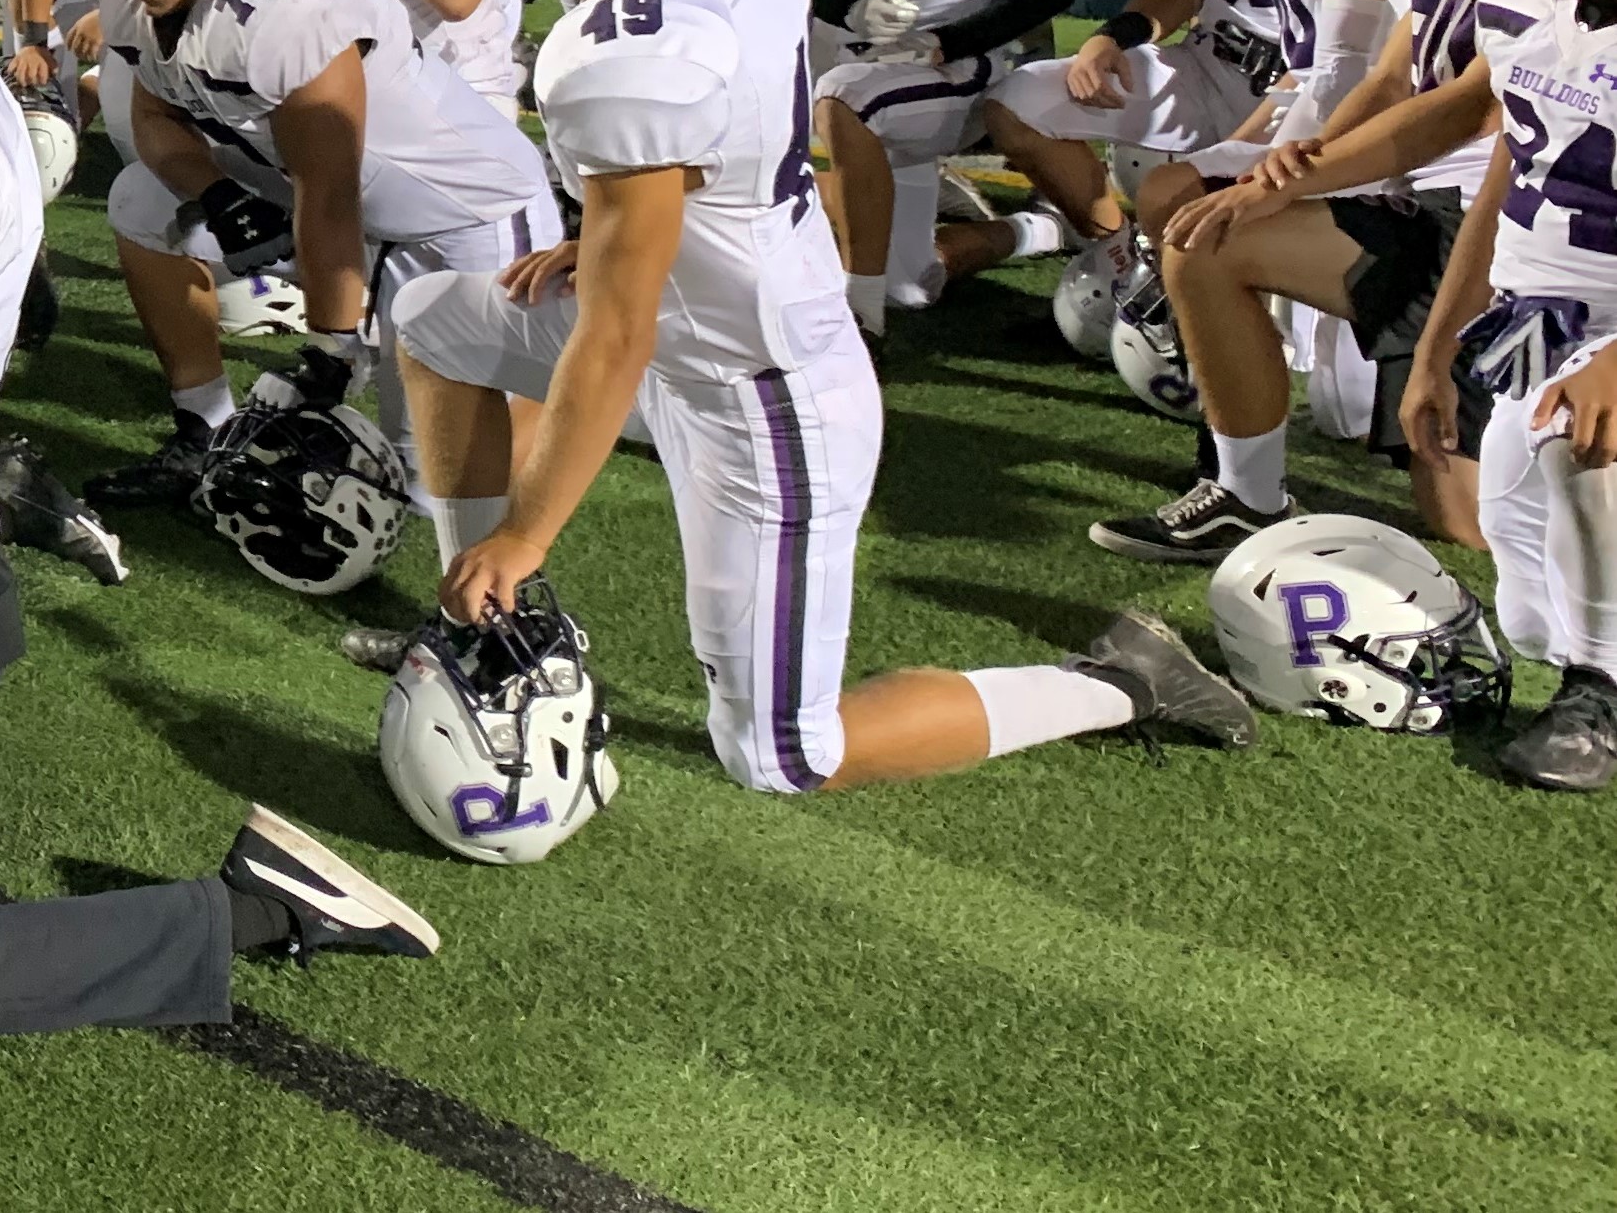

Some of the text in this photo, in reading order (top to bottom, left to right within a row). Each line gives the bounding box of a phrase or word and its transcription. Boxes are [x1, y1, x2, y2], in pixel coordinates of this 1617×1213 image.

[1507, 64, 1602, 116] BULLDOGS
[1500, 89, 1617, 256] 24
[1275, 580, 1350, 669] P
[447, 782, 554, 839] P
